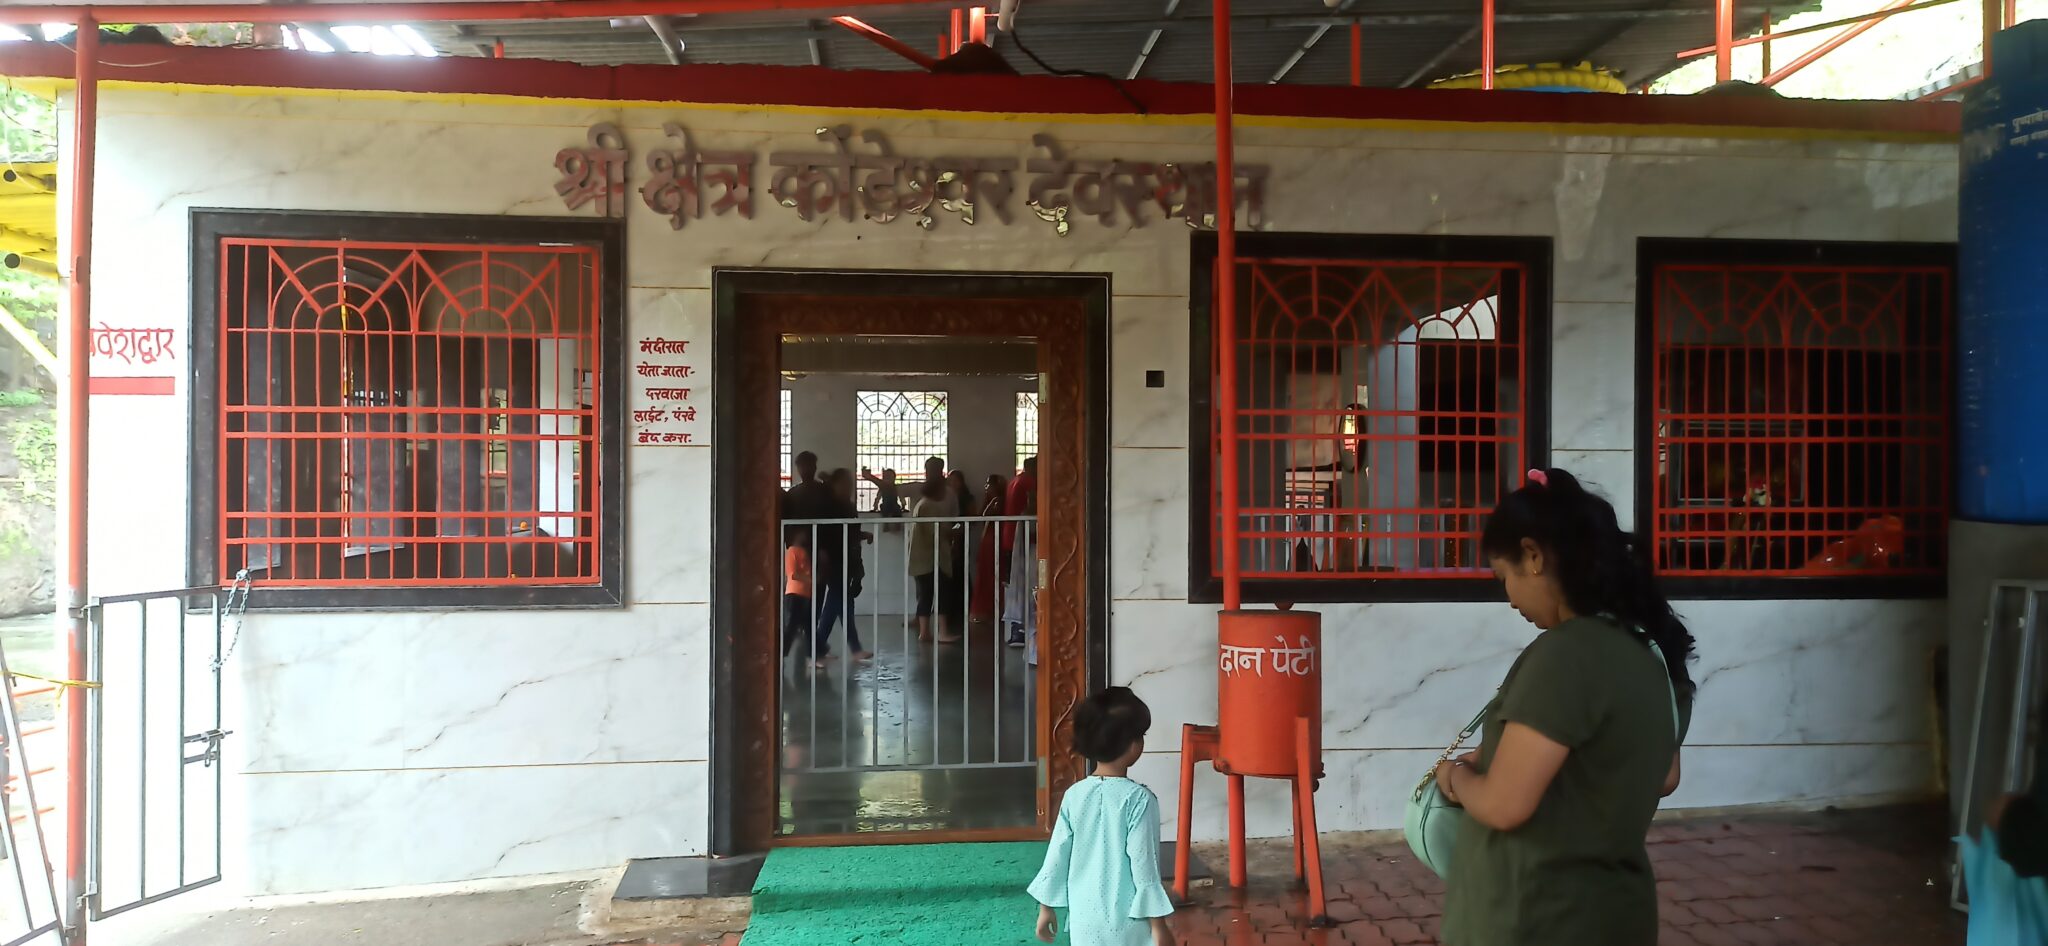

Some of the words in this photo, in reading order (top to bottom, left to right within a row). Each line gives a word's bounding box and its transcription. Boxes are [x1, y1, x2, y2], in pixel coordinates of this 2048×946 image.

[554, 121, 628, 218] श्री
[639, 122, 755, 231] क्षेत्र
[639, 337, 690, 354] मंदीरात
[645, 388, 690, 400] दरवाजा
[638, 429, 661, 443] बंद
[1220, 644, 1266, 678] दान
[1269, 634, 1316, 678] पेटी
